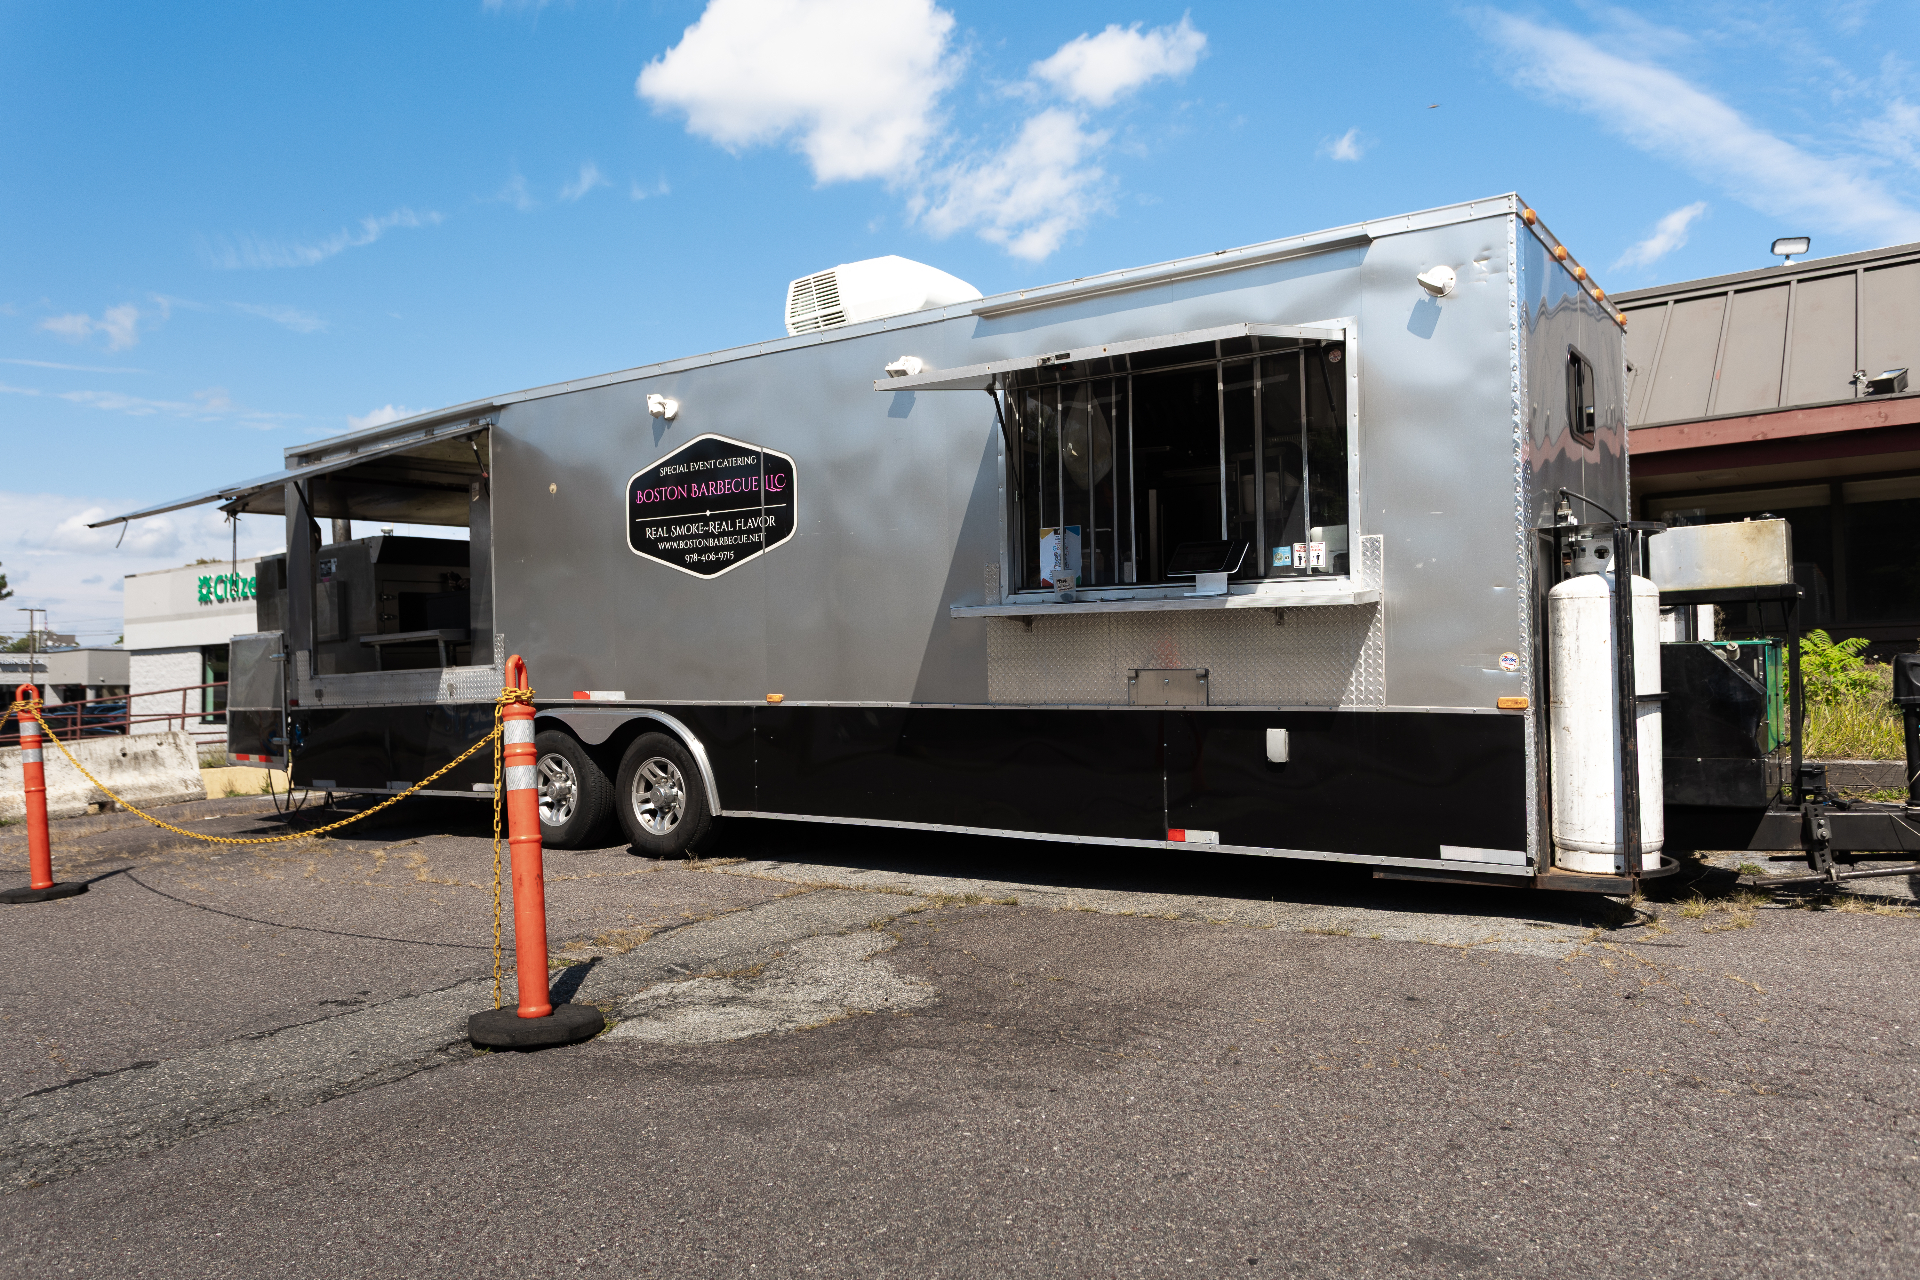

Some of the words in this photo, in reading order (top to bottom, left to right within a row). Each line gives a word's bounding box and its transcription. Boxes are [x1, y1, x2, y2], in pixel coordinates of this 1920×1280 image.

[659, 463, 688, 477] SPECIAL
[690, 460, 715, 471] EVENT
[716, 455, 757, 468] CATERING
[635, 484, 688, 504] BOSTON
[690, 476, 759, 498] BARBECUE
[765, 473, 787, 492] LLC
[645, 526, 669, 540] REAL
[736, 515, 776, 531] FLAVOR
[657, 532, 767, 550] WWW.BOSTONBARBECUE.NET
[684, 551, 735, 564] 978-406-9715
